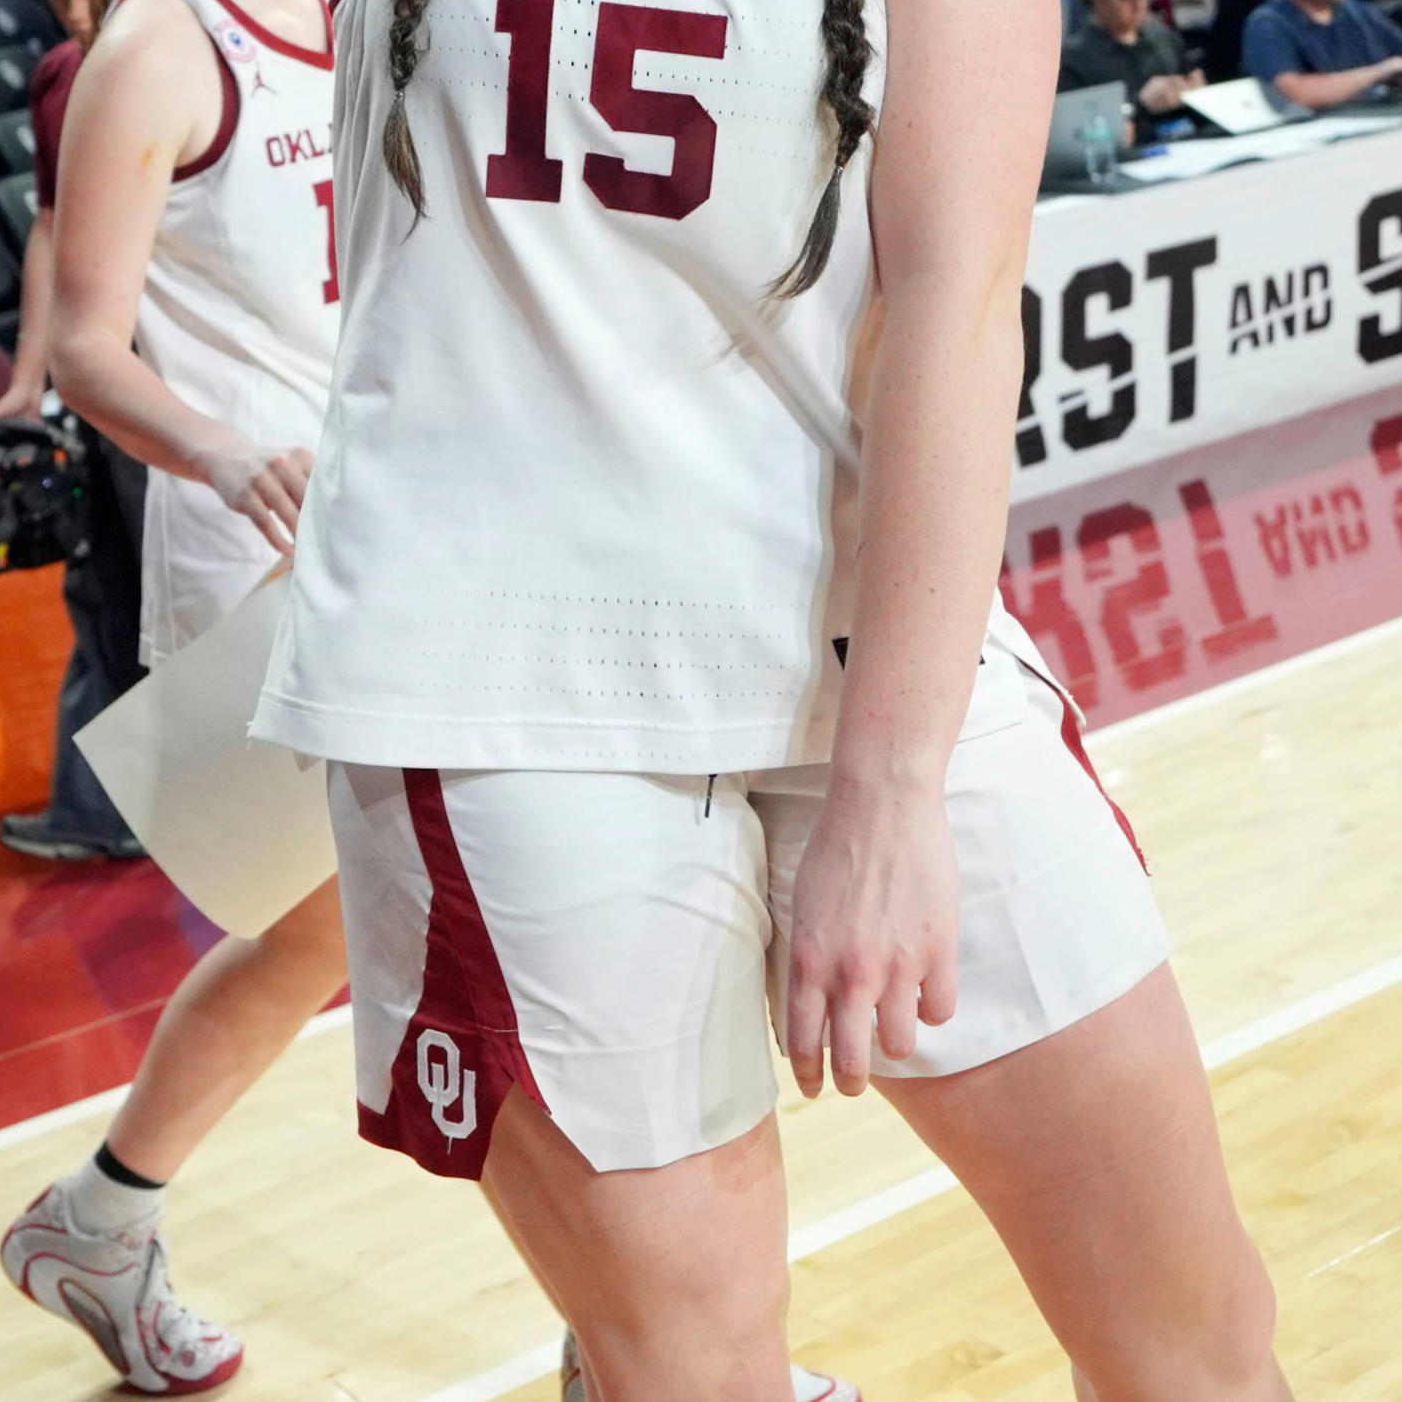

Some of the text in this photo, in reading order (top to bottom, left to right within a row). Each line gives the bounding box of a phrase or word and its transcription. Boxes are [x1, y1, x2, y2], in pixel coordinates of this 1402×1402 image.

[265, 122, 333, 167] OKL
[1228, 263, 1333, 355] AND
[417, 1028, 477, 1139] OU
